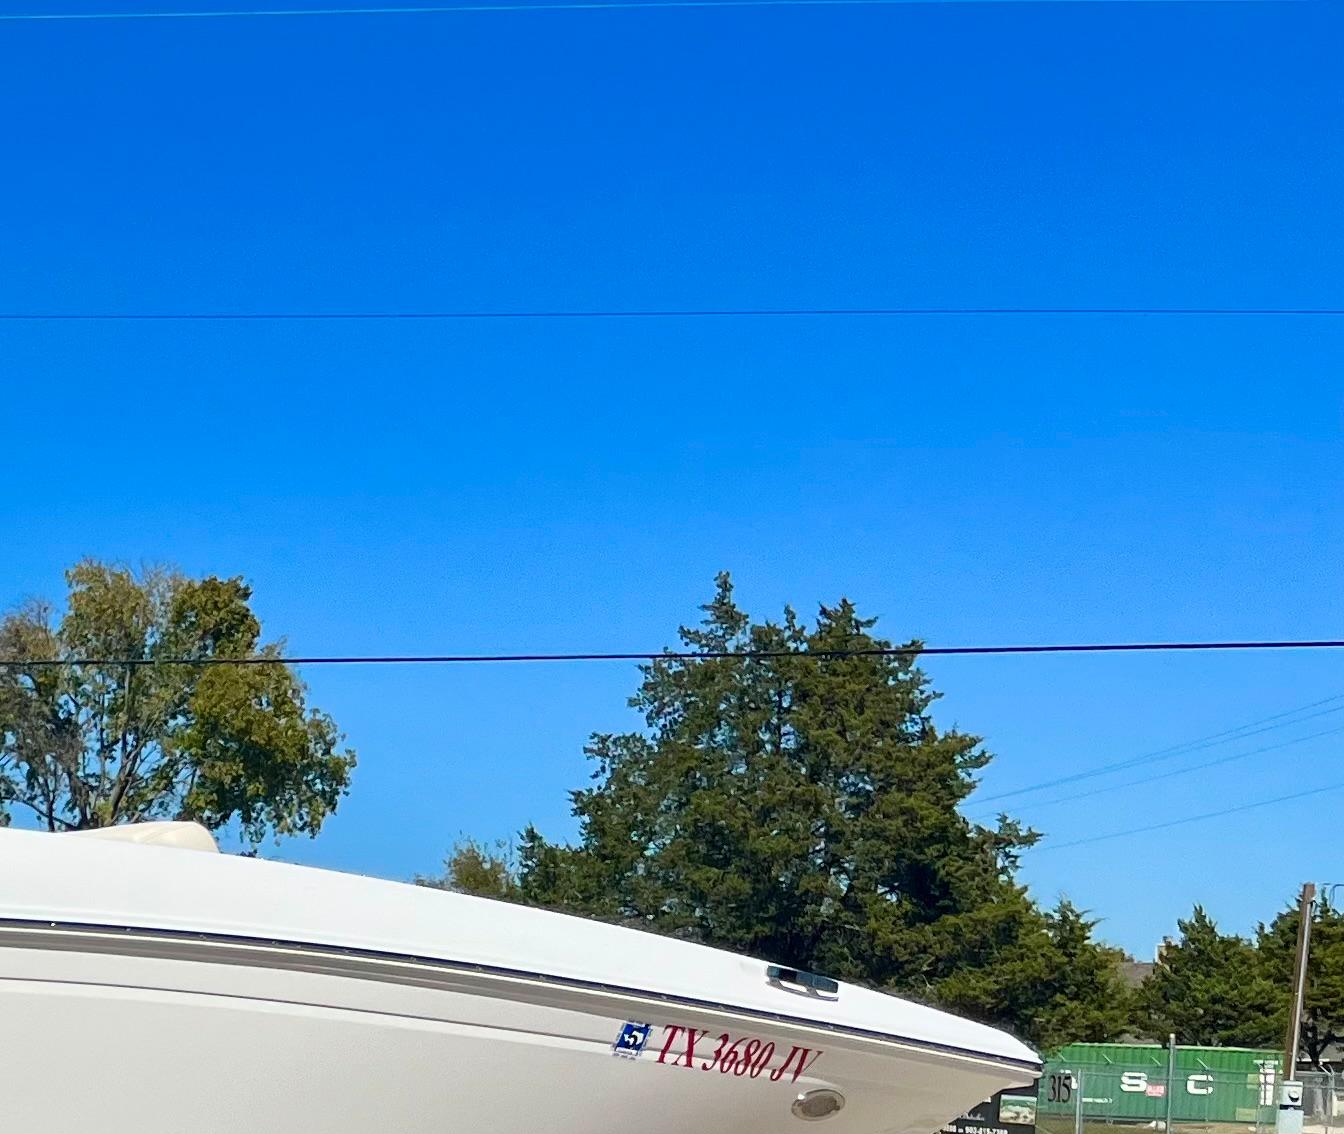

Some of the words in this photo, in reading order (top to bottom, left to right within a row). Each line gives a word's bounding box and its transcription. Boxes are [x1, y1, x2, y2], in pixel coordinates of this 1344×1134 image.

[656, 1024, 710, 1069] TX
[702, 1033, 776, 1079] 3680
[770, 1045, 824, 1084] JV
[1047, 1074, 1073, 1104] 315
